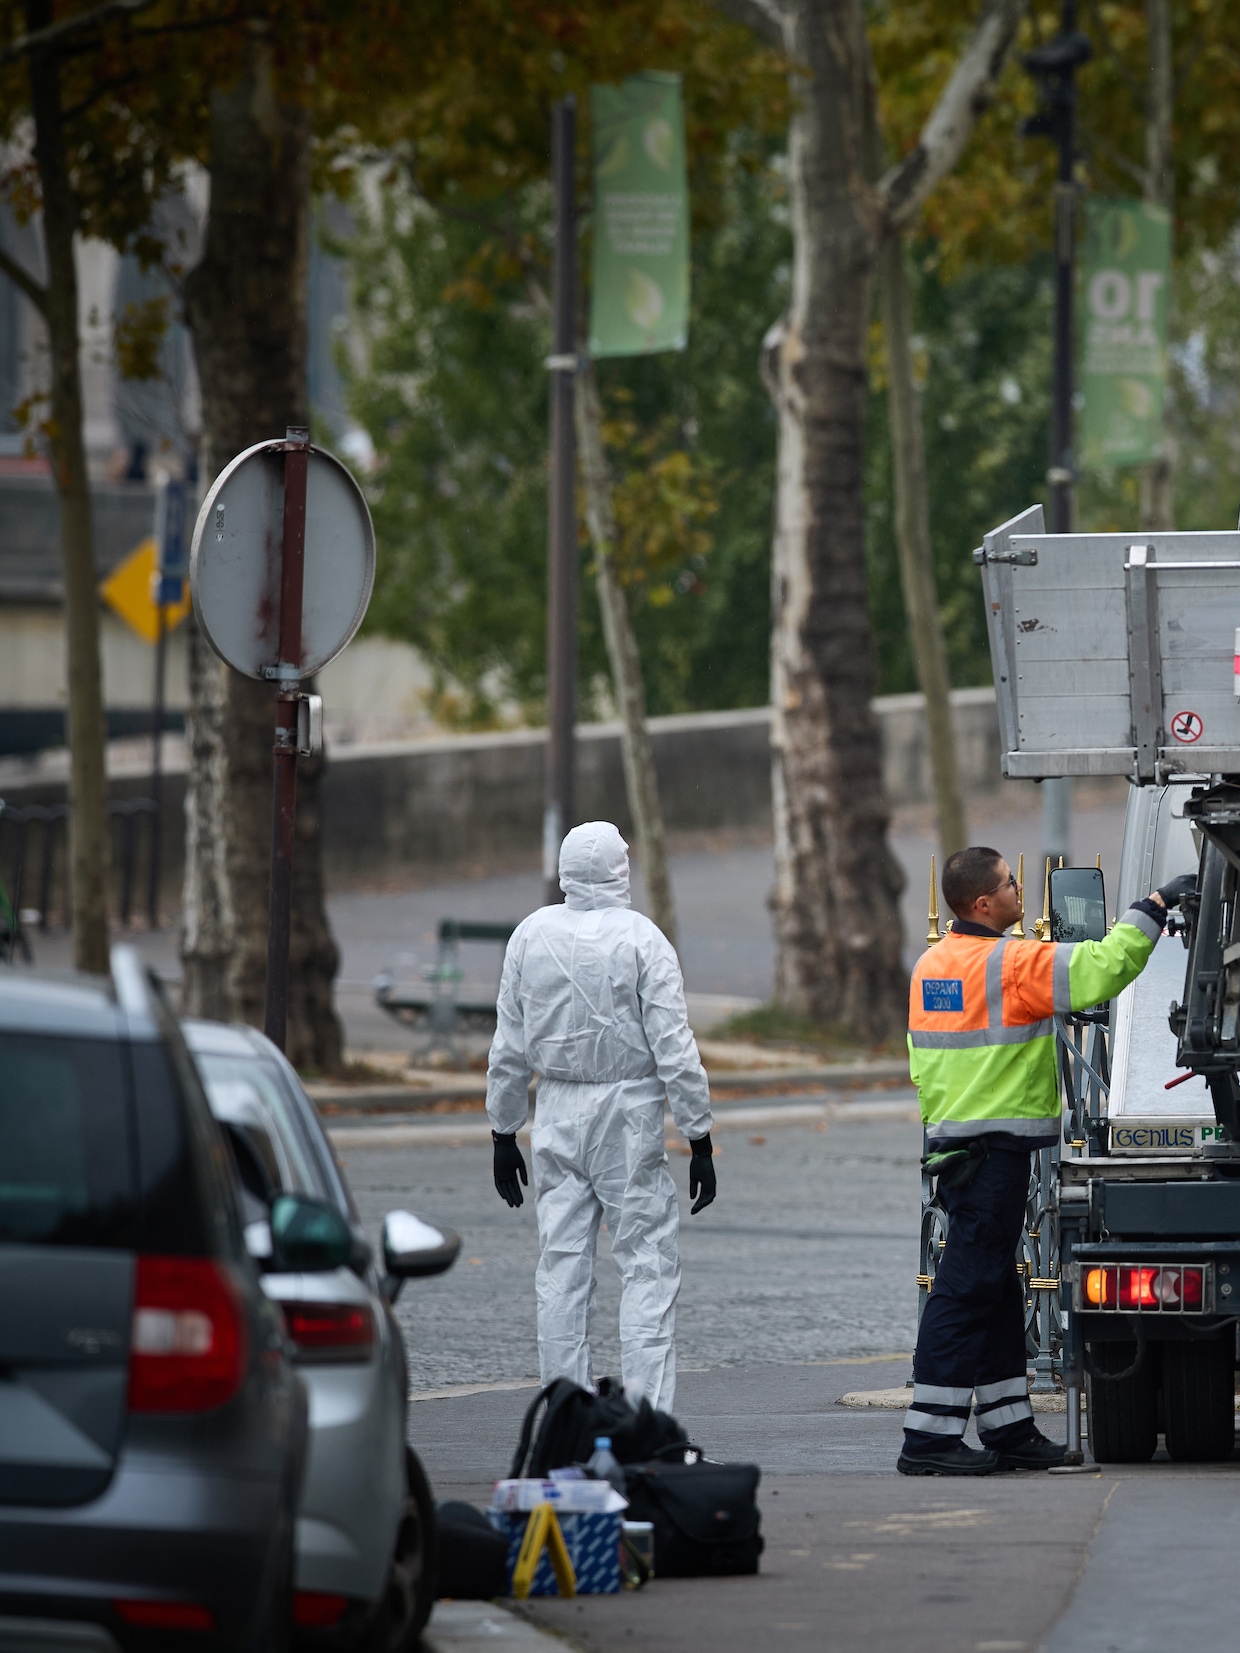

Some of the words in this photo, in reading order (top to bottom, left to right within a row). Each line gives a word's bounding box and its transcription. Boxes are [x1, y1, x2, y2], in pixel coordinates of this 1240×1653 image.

[925, 982, 958, 995] DEPANN
[933, 997, 951, 1009] 2000
[1116, 1129, 1194, 1146] GENIUS
